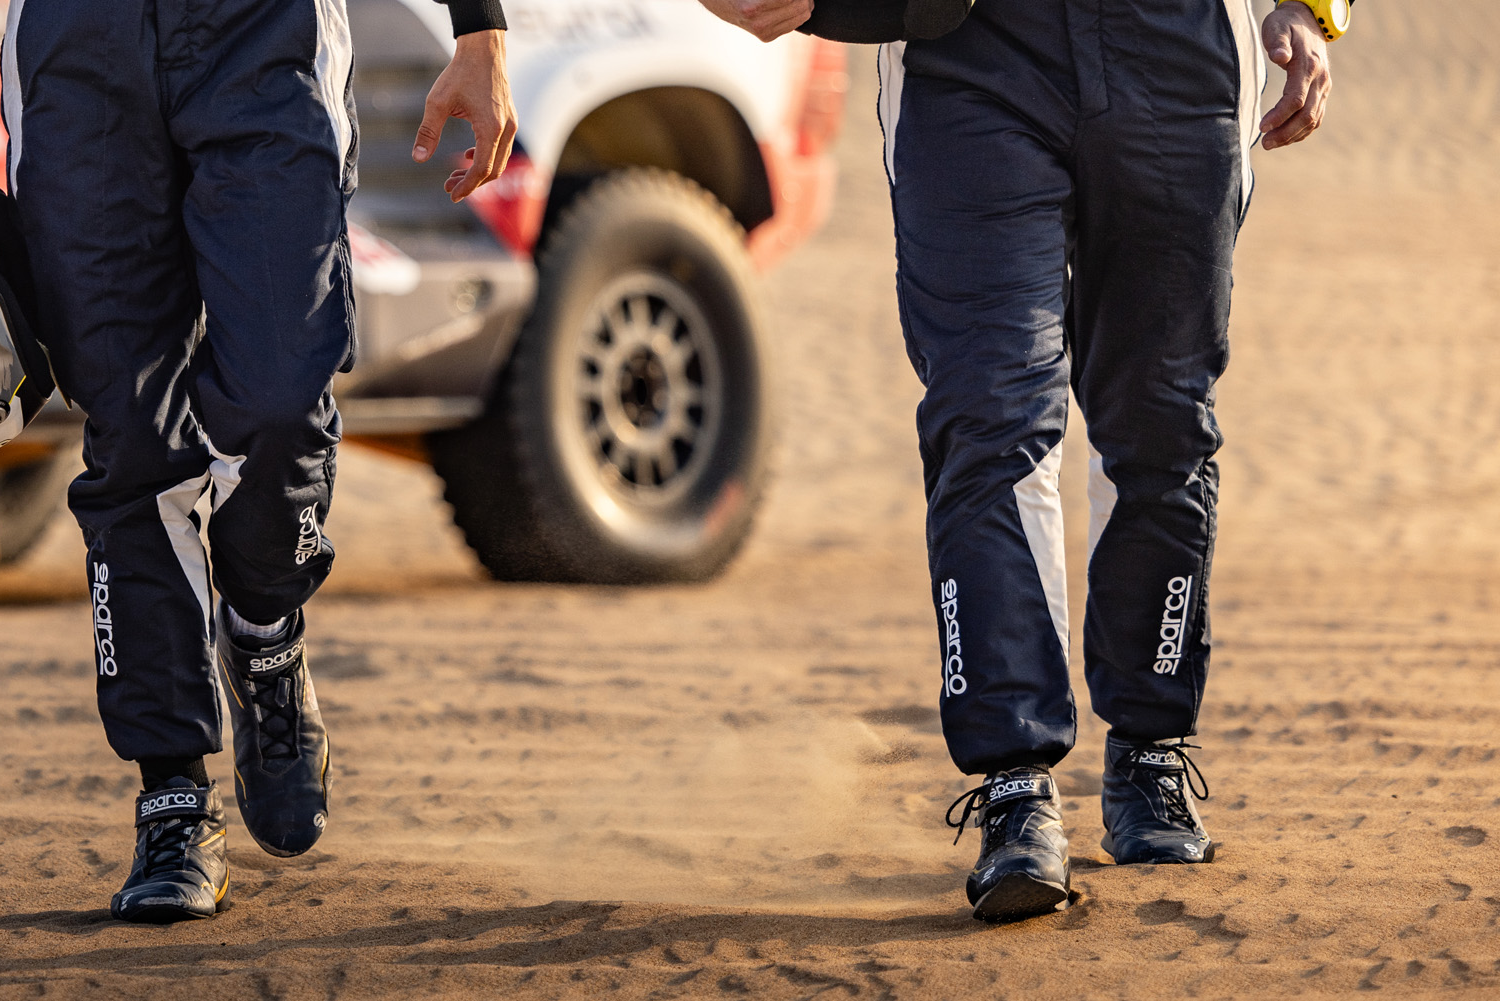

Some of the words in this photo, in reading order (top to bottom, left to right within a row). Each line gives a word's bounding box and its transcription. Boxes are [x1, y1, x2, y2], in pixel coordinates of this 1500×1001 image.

[93, 562, 118, 677] sparco
[941, 578, 967, 698] sparco
[1153, 575, 1193, 676] sparco
[250, 638, 304, 672] sparco
[141, 793, 198, 817] sparco
[989, 779, 1038, 802] sparco
